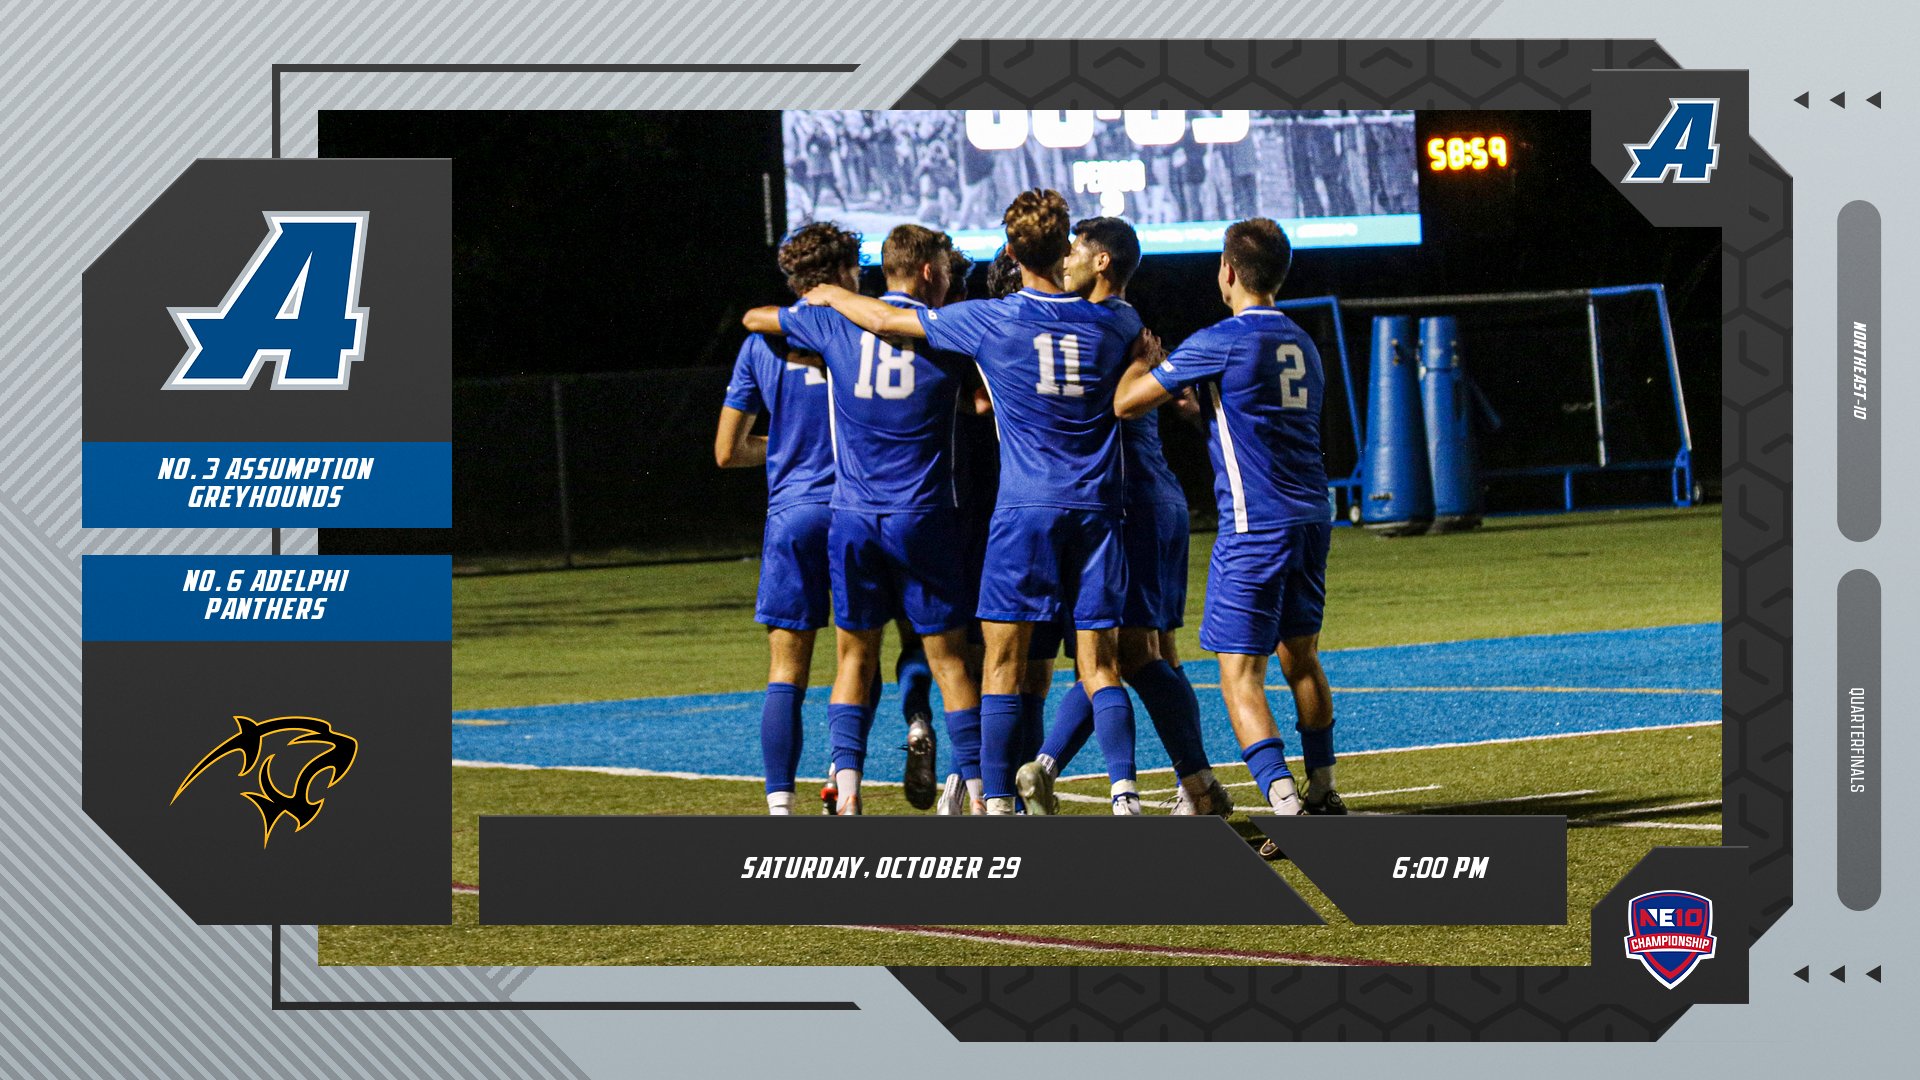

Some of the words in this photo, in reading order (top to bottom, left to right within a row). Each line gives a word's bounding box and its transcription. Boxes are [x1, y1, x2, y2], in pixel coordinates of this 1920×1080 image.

[1427, 136, 1507, 171] 58:59
[854, 331, 916, 399] 18
[1033, 333, 1085, 397] 11
[1276, 344, 1308, 409] 2
